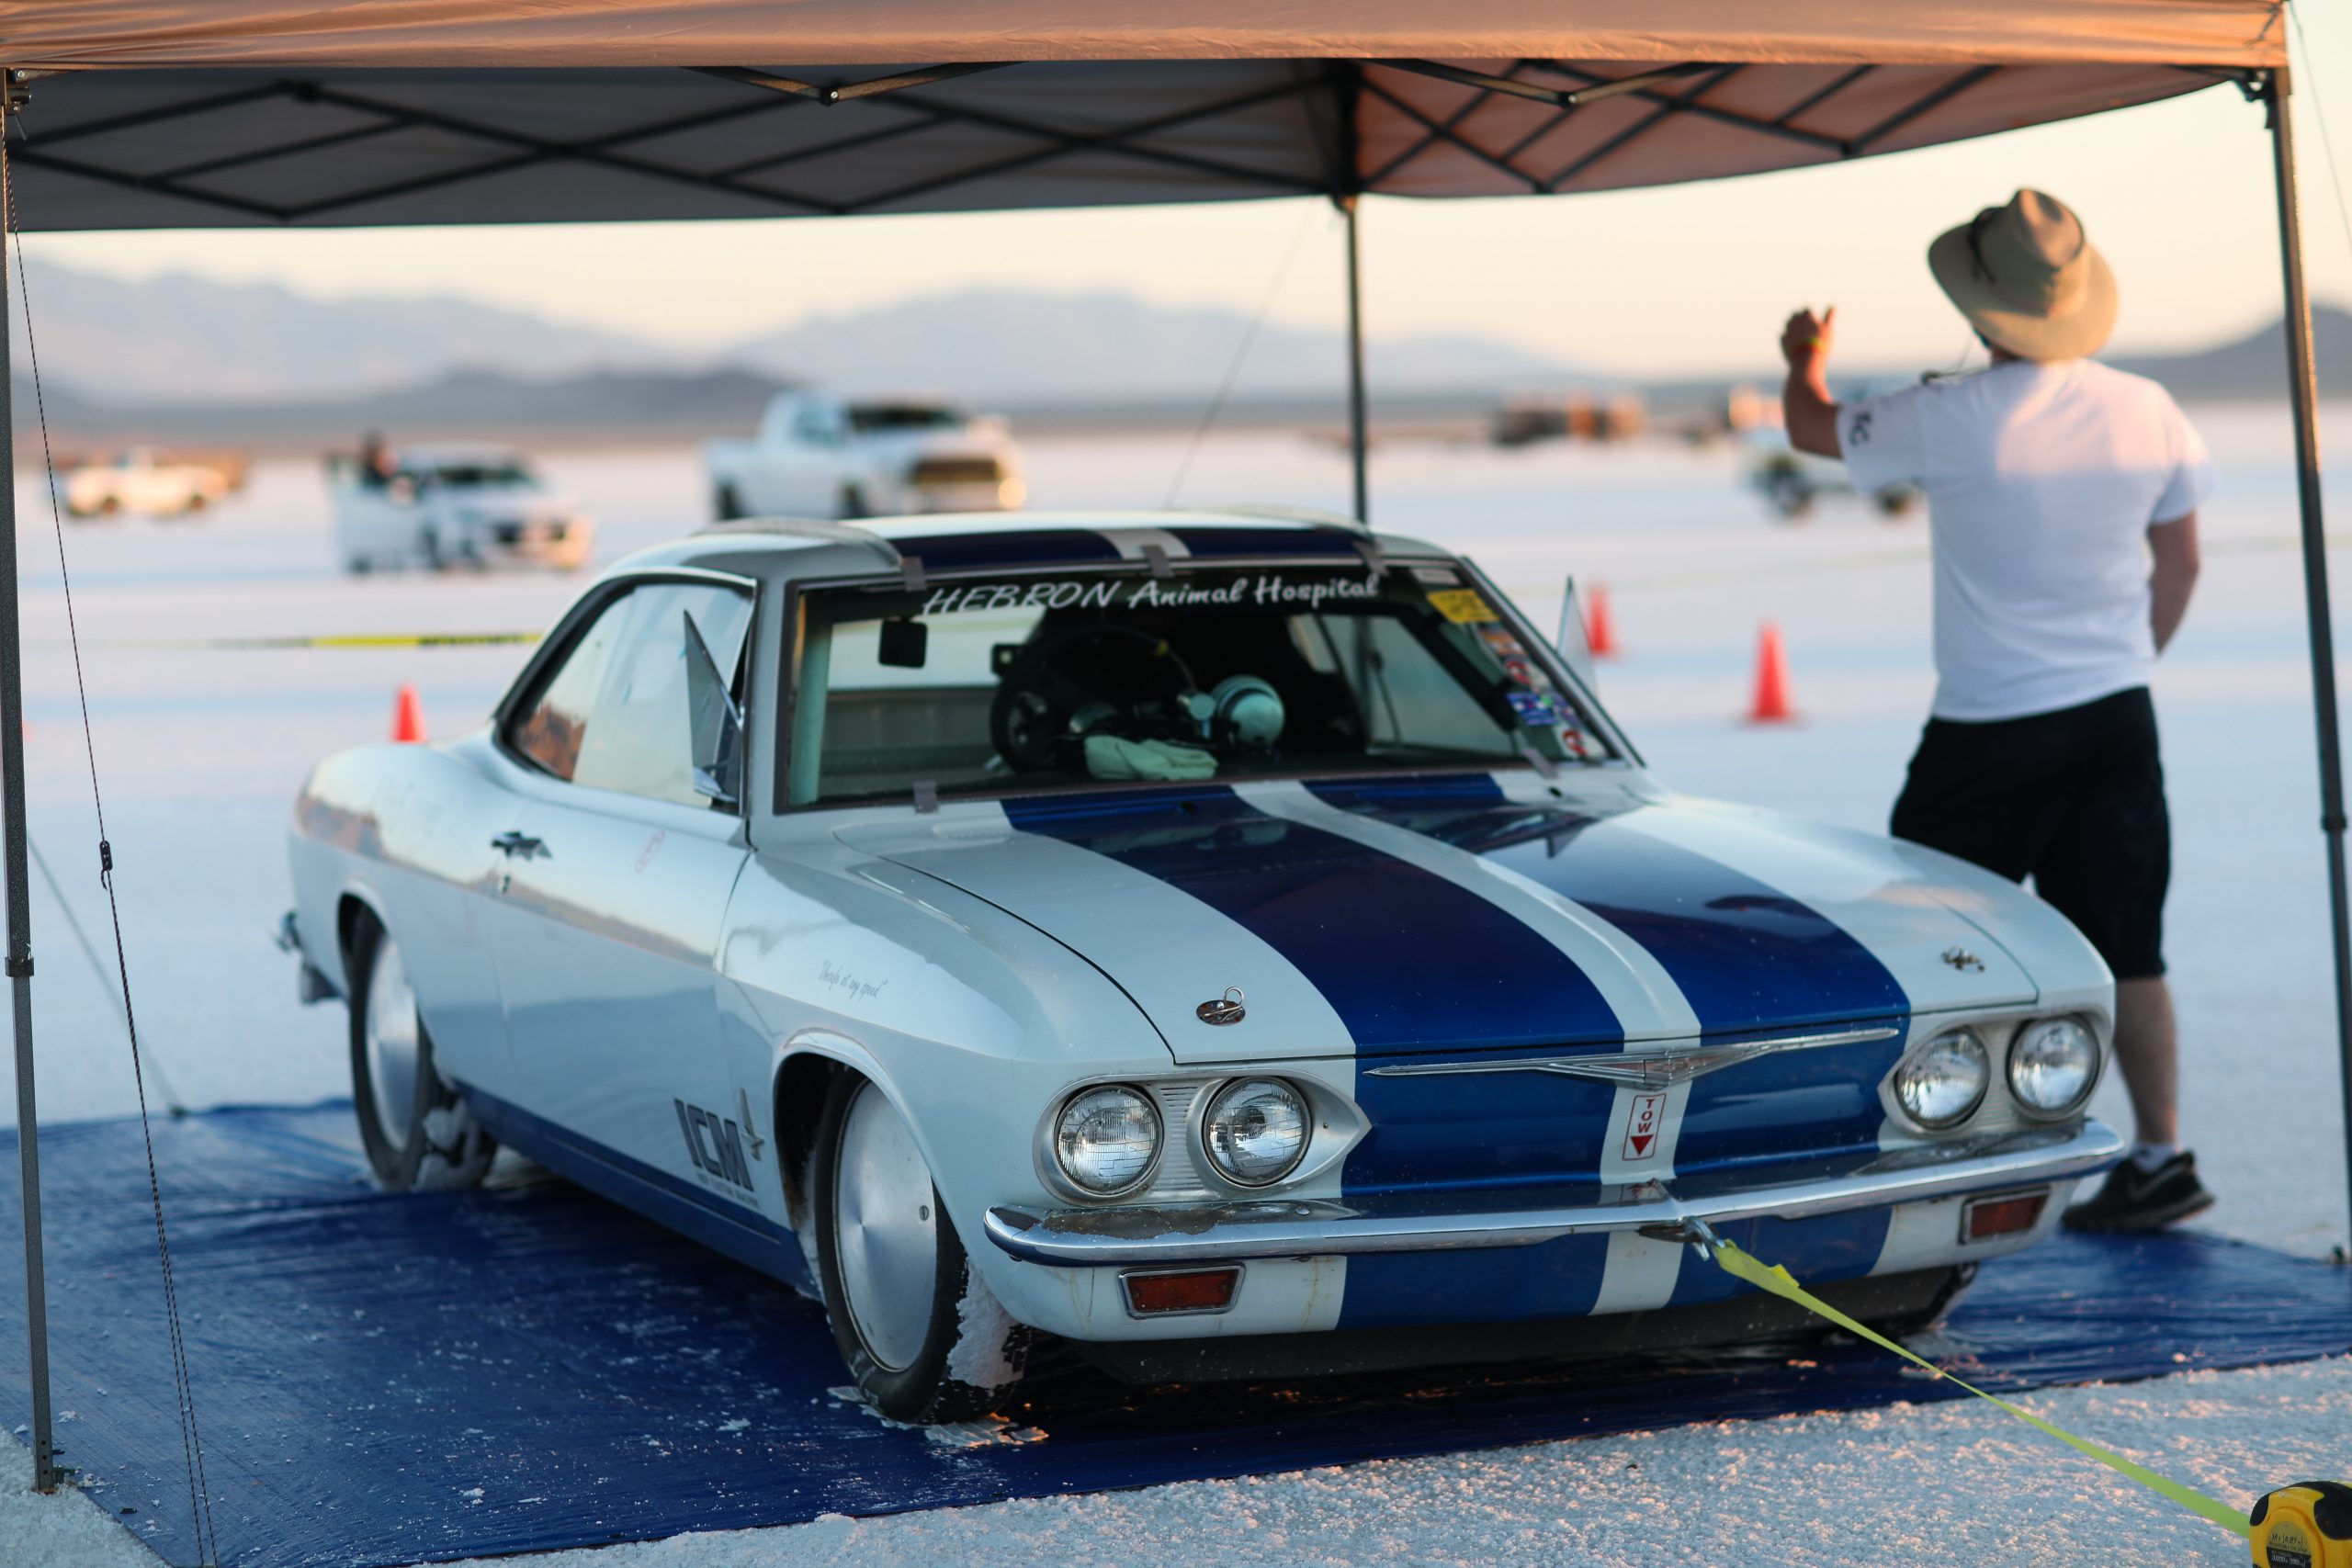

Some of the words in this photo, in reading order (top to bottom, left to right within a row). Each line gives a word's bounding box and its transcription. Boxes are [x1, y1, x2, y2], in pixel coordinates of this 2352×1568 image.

[922, 580, 1123, 616] HEBRON
[1128, 578, 1250, 610] Animal
[1253, 572, 1380, 609] Hospital
[1637, 1099, 1656, 1134] TOW
[673, 1098, 754, 1192] ICM
